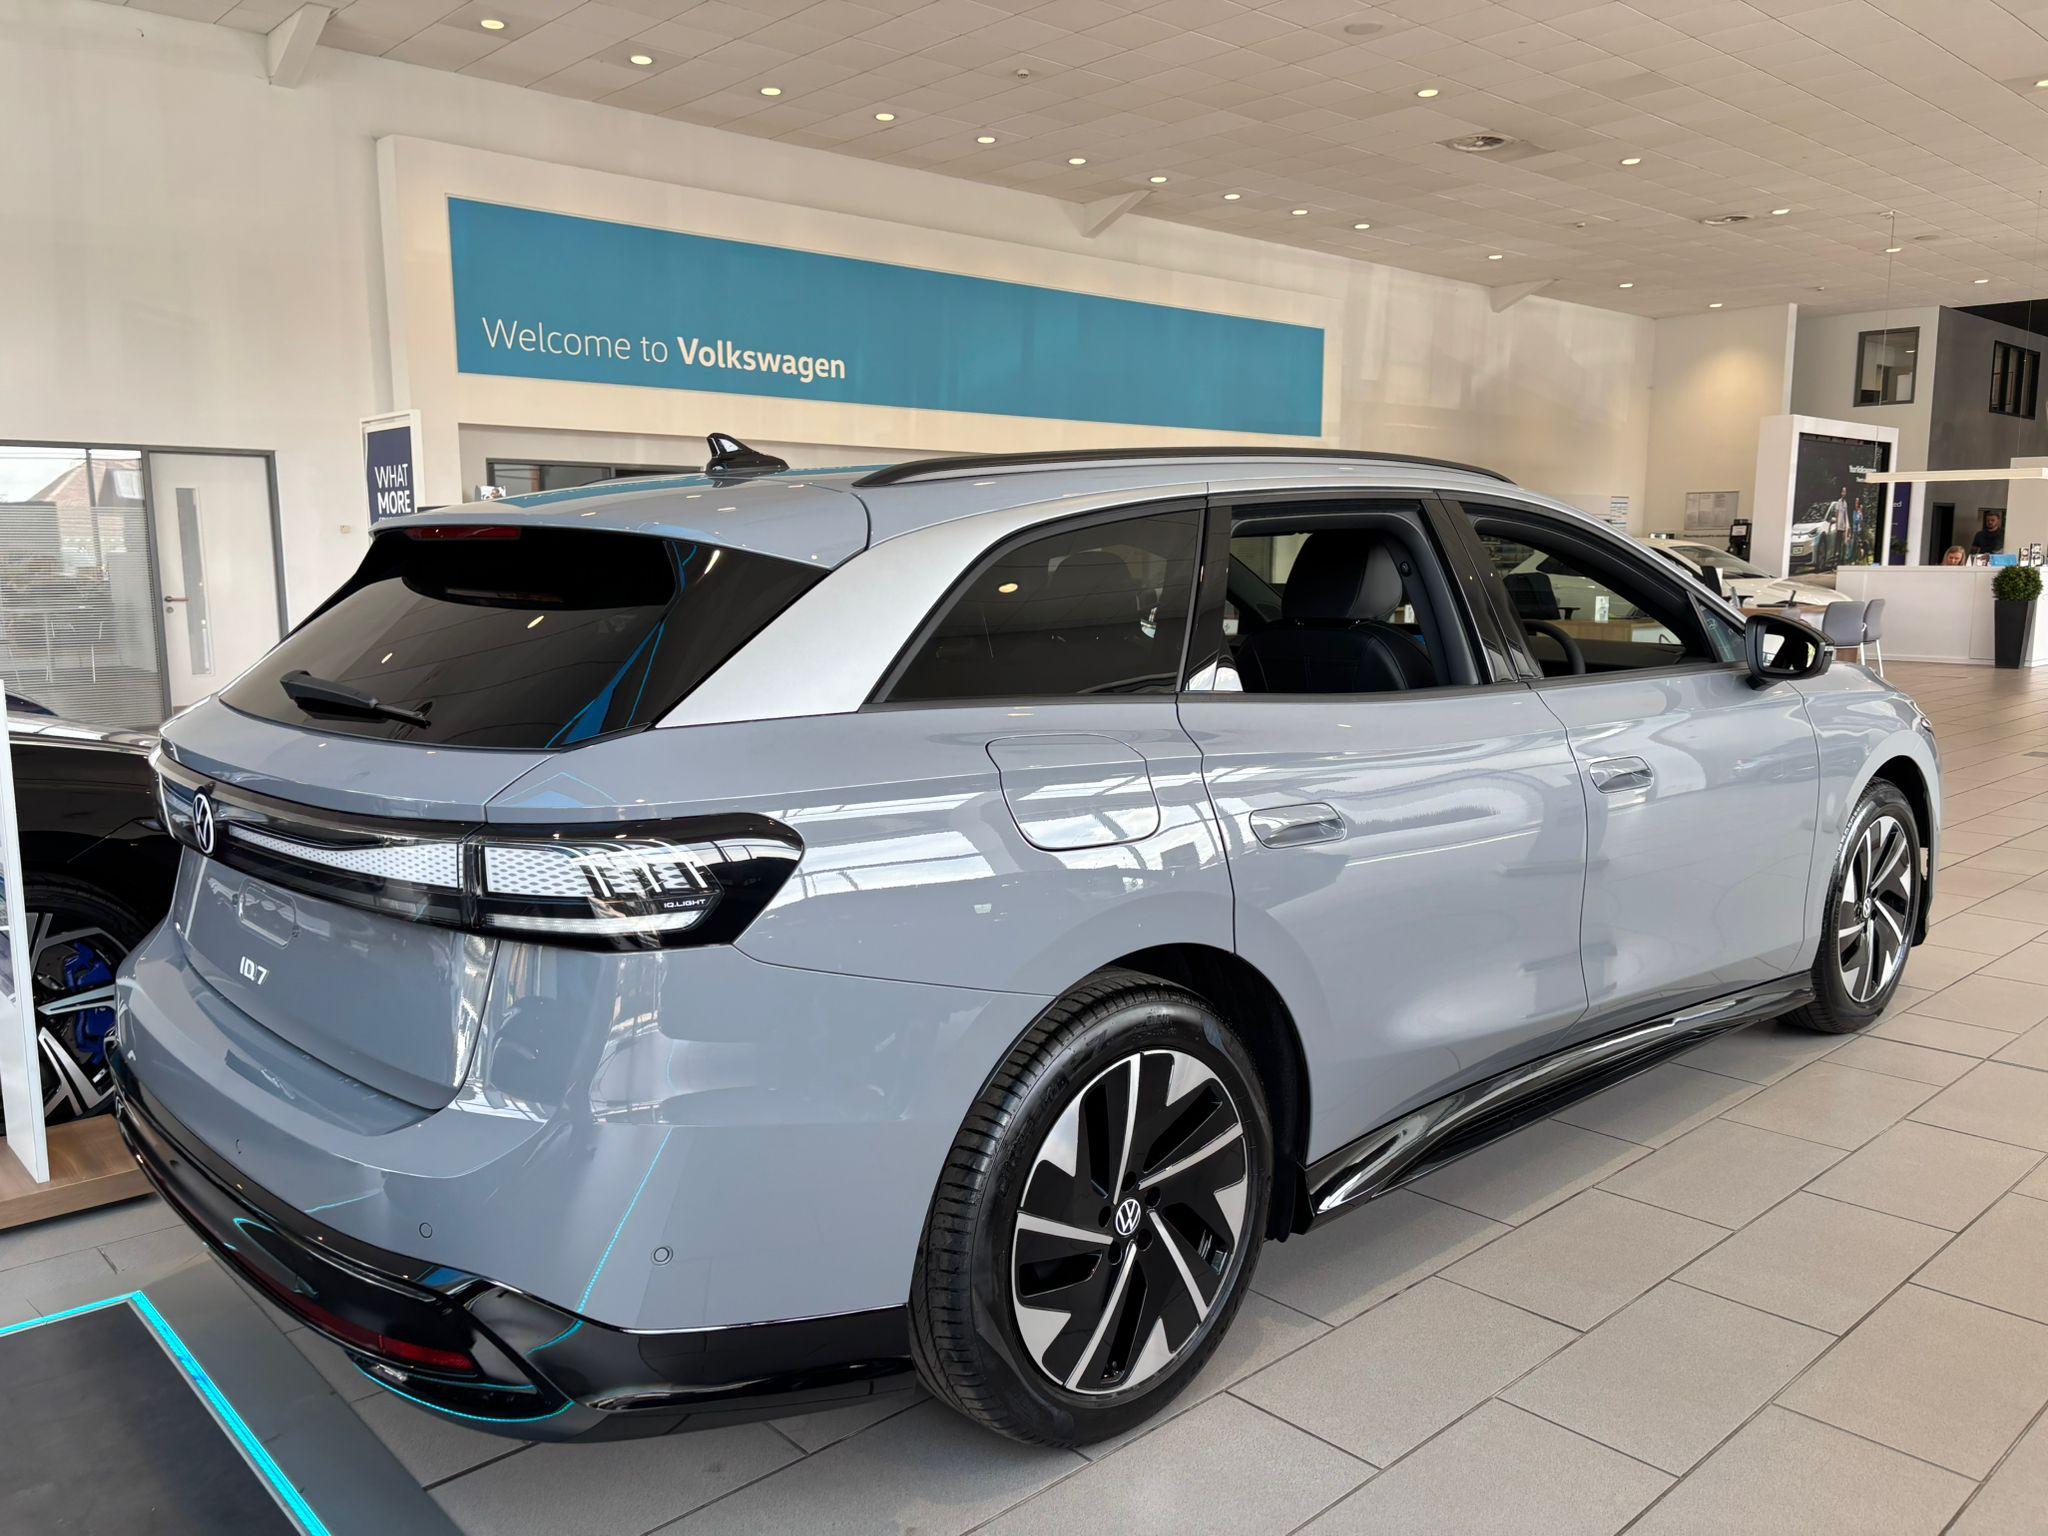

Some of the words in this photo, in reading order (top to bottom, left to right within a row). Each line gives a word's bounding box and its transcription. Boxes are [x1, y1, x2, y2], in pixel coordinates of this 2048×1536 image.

[481, 316, 631, 360] Welcome
[639, 336, 669, 363] to
[676, 336, 847, 384] Volkswagen
[374, 463, 409, 489] WHAT
[377, 490, 412, 515] MORE
[663, 898, 706, 909] IQ.LIGHT
